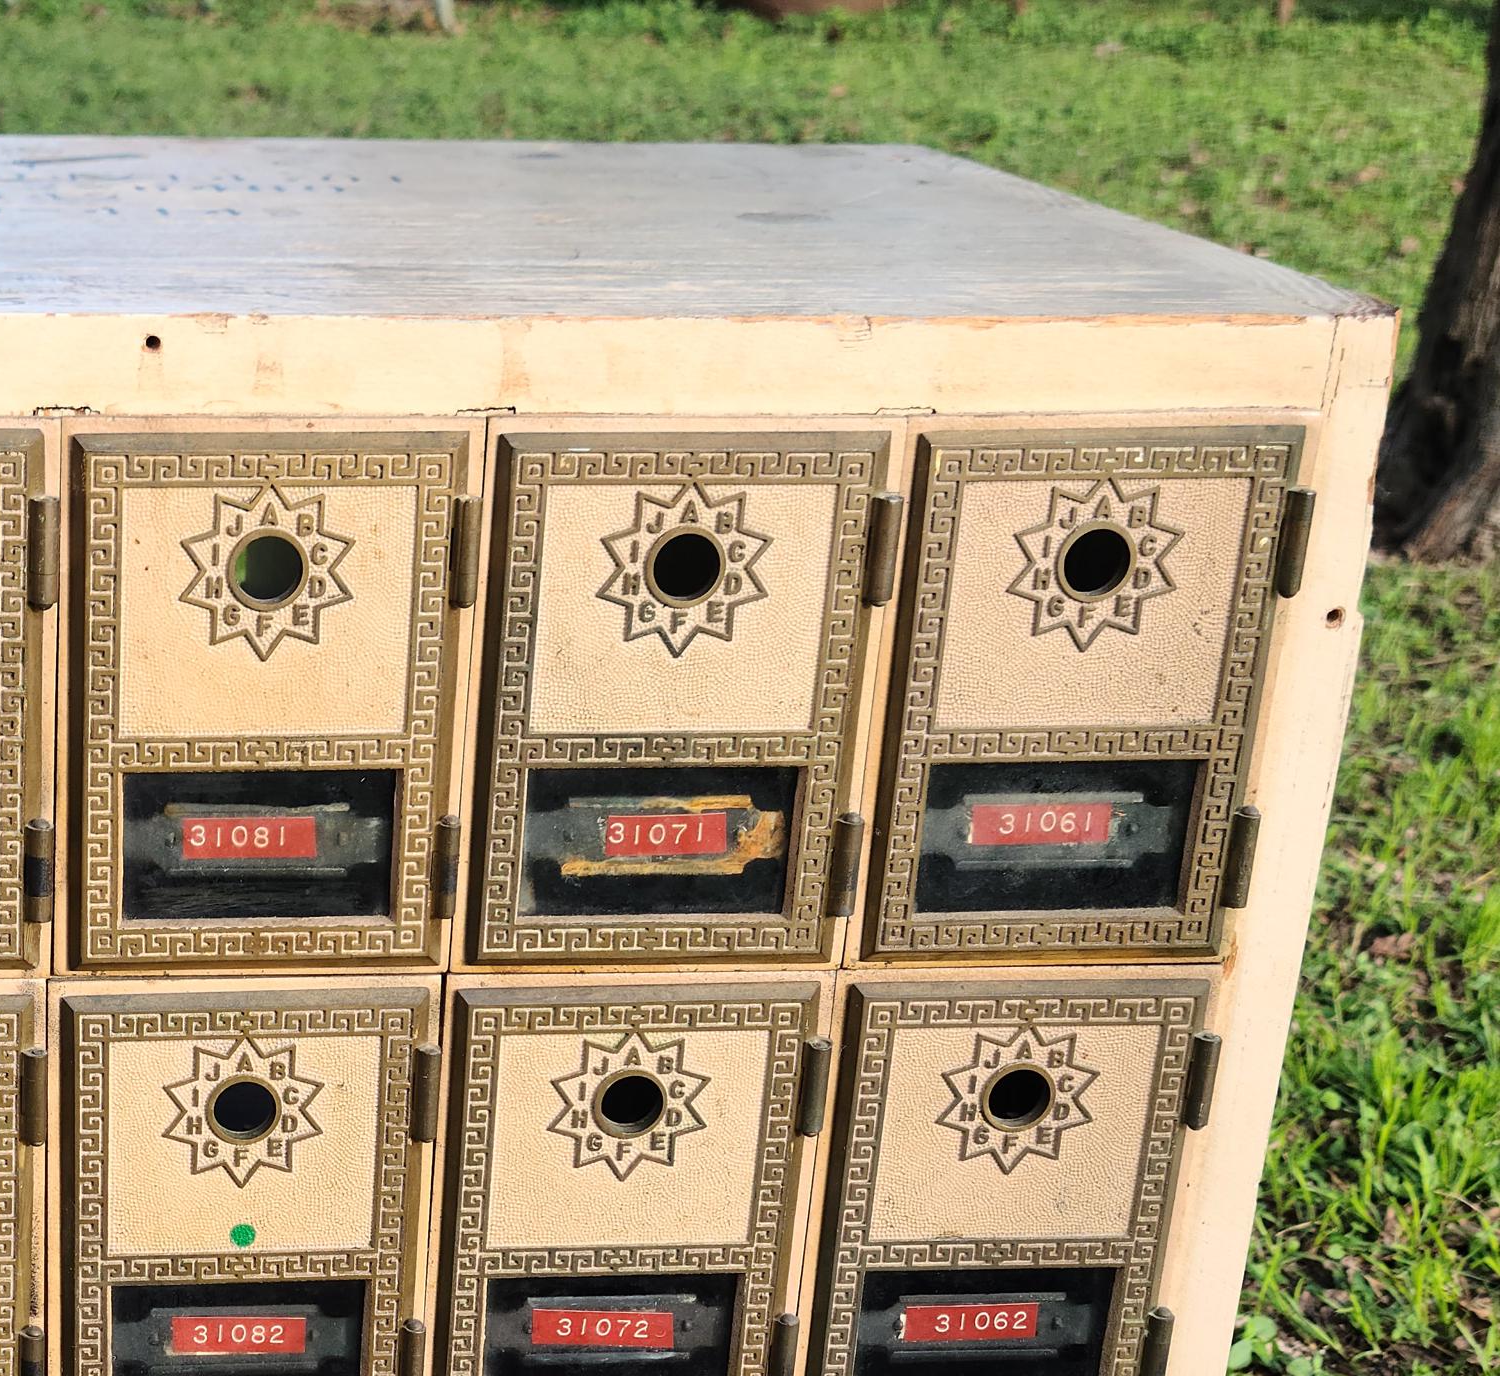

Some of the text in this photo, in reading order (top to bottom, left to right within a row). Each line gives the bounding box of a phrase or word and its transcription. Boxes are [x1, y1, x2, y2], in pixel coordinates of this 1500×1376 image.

[261, 503, 279, 525] A
[1094, 496, 1114, 517] A
[1129, 506, 1146, 528] B
[226, 515, 242, 537] J
[297, 514, 313, 535] B
[1060, 508, 1076, 529] J
[310, 544, 328, 565] C
[1141, 536, 1157, 557] C
[206, 577, 223, 599] H
[308, 577, 326, 599] D
[1034, 568, 1050, 590] H
[1133, 568, 1151, 588] D
[224, 605, 240, 627] G
[292, 605, 309, 626] E
[1048, 597, 1065, 618] G
[1078, 607, 1097, 628] F
[1115, 596, 1132, 618] E
[256, 615, 274, 637] F
[608, 822, 702, 843] 31071
[999, 811, 1091, 834] 31061
[190, 825, 285, 847] 31081
[594, 1057, 608, 1075] J
[624, 1047, 641, 1066] A
[659, 1056, 674, 1075] B
[669, 1081, 685, 1099] C
[572, 1109, 587, 1128] H
[666, 1108, 682, 1126] D
[586, 1133, 602, 1152] G
[617, 1141, 632, 1160] F
[650, 1132, 666, 1150] E
[557, 1318, 648, 1338] 31072
[935, 1311, 1027, 1333] 31062
[193, 1324, 284, 1344] 31082
